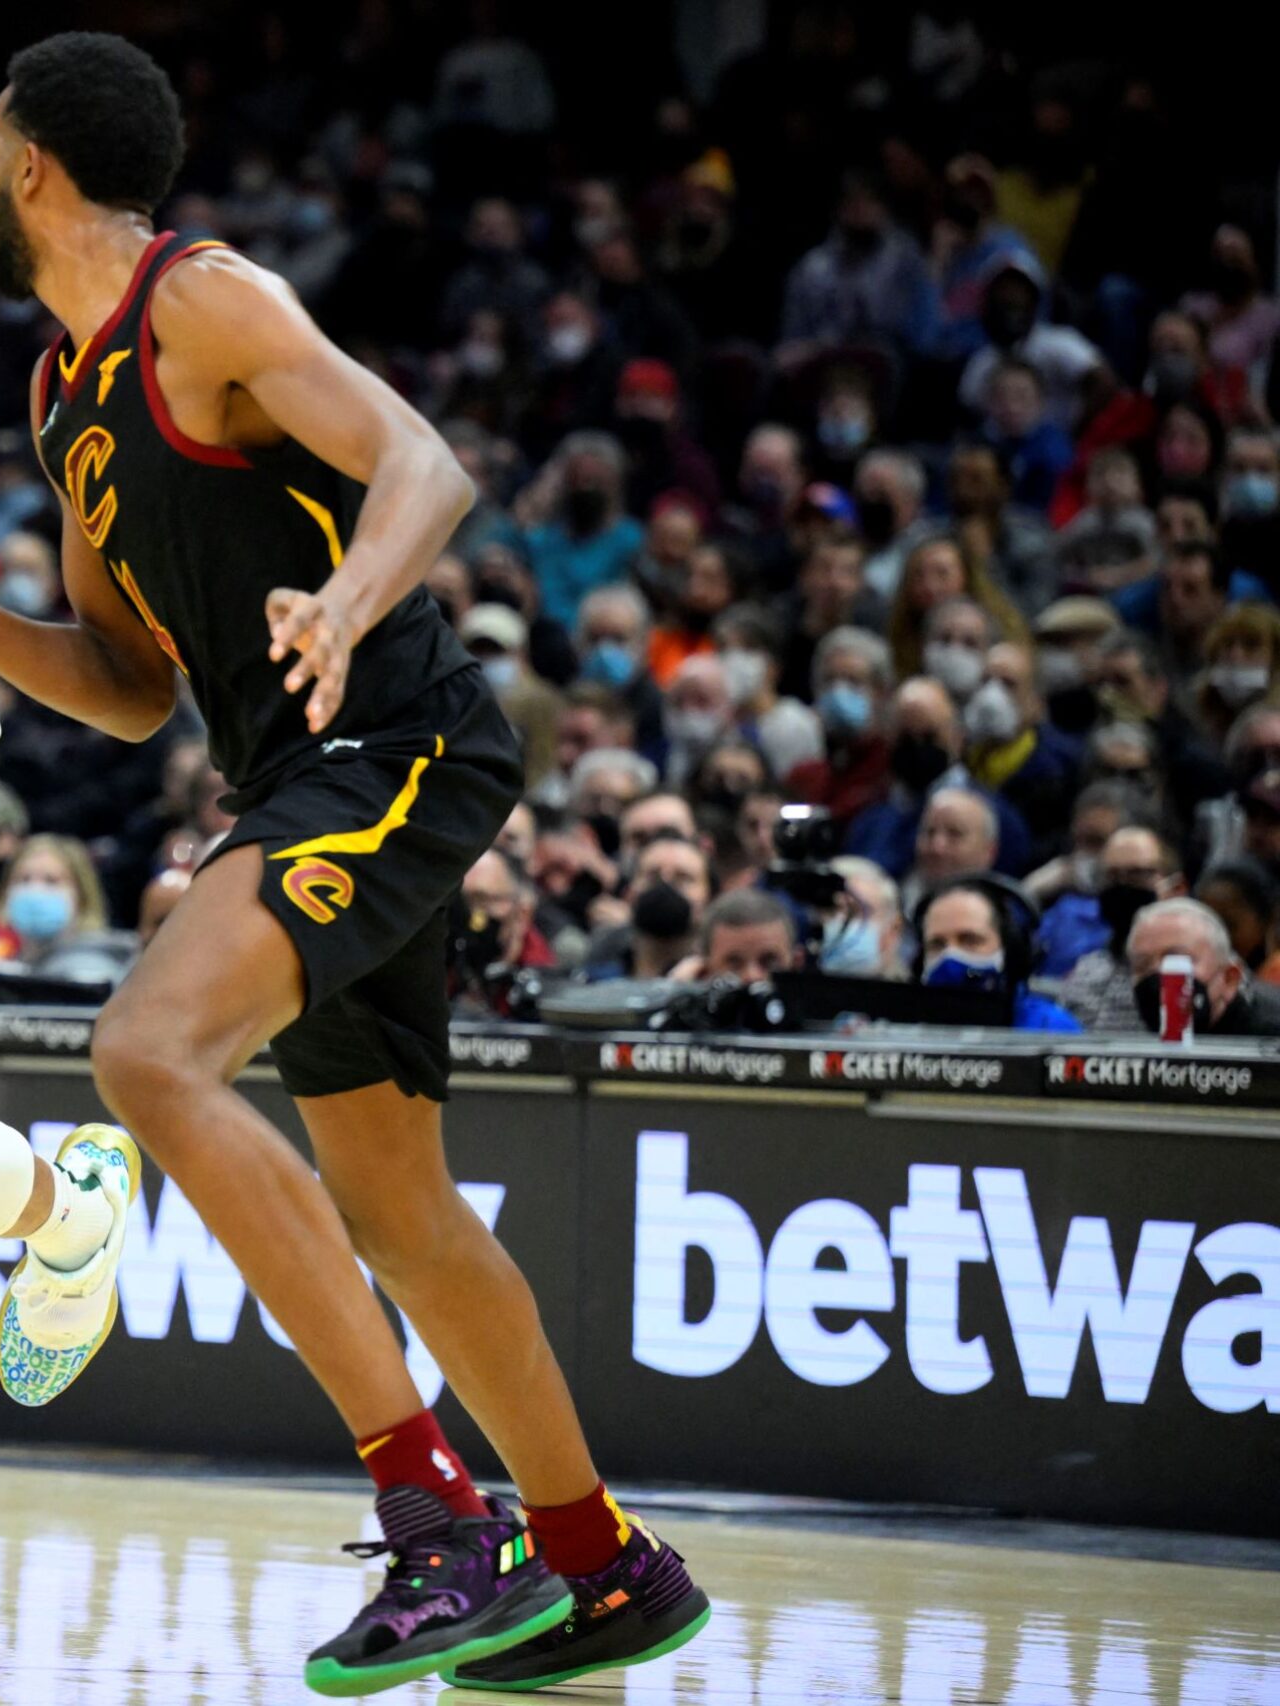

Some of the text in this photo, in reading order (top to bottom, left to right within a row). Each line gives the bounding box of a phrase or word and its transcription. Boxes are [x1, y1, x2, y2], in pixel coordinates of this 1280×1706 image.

[599, 1042, 786, 1082] ROCKET Mortgage
[809, 1051, 1004, 1088] ROCKET Mortgage
[1046, 1056, 1253, 1096] ROCKET Mortgage
